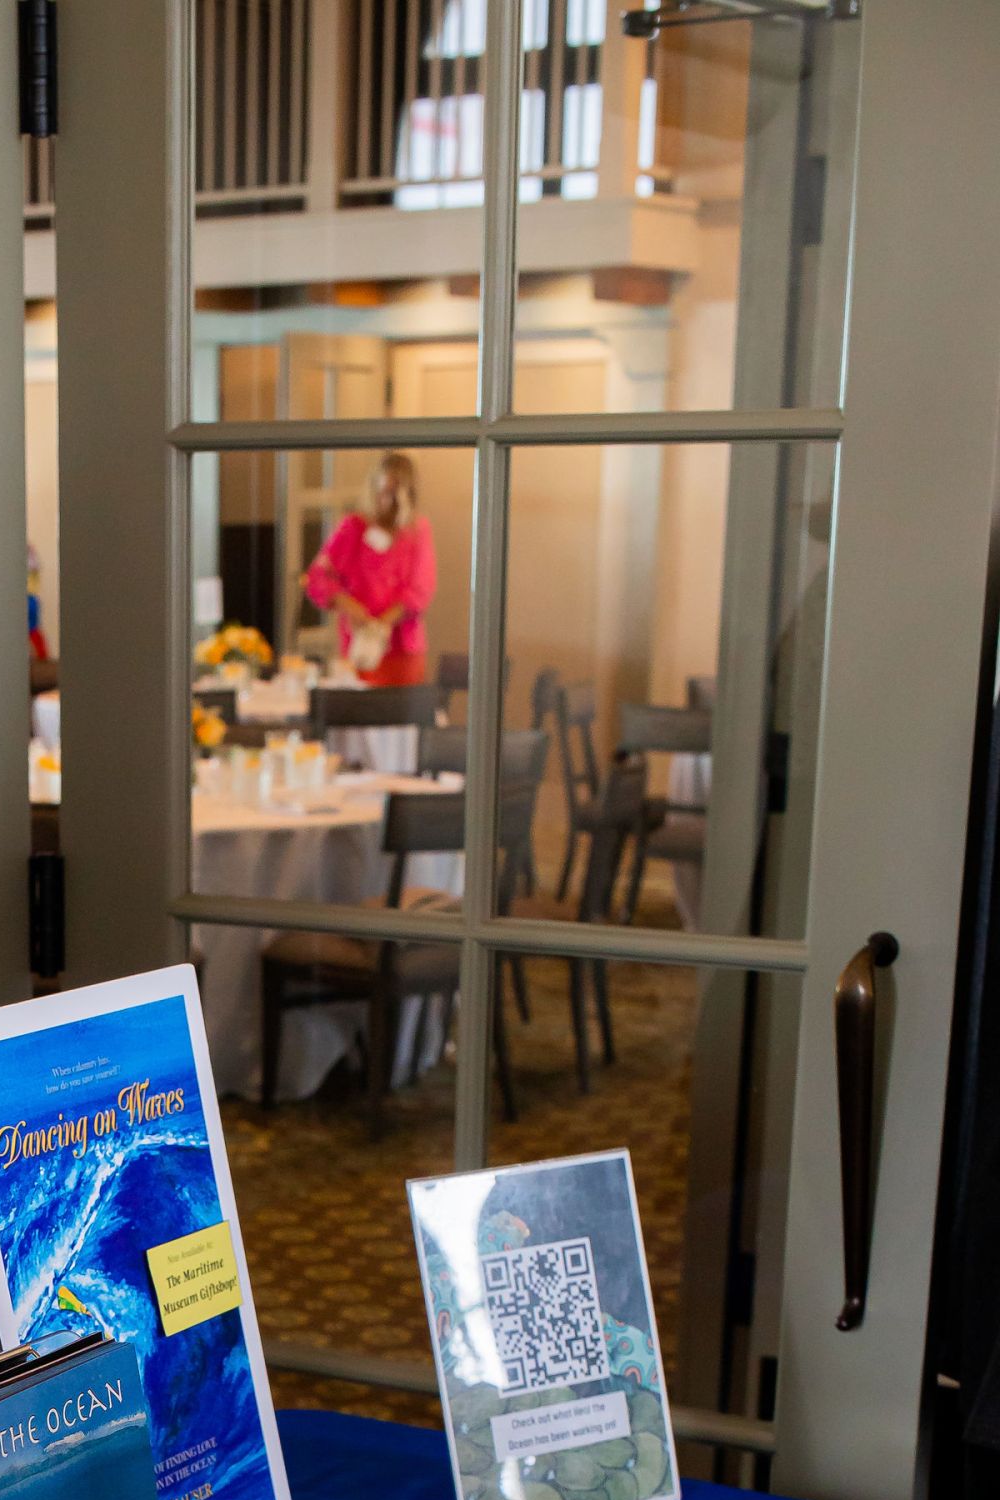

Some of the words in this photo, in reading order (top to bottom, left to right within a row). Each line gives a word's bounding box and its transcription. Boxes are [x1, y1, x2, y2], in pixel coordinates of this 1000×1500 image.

[94, 1107, 119, 1137] on
[117, 1078, 186, 1126] Waves
[165, 1275, 182, 1290] The
[183, 1258, 224, 1283] Maritime
[162, 1292, 199, 1317] Museum
[199, 1276, 238, 1302] Giftshop!
[46, 1380, 124, 1434] OCEAN
[511, 1415, 535, 1429] Check
[164, 1446, 197, 1469] FINDING
[196, 1436, 218, 1454] LOVE
[172, 1465, 191, 1482] THE
[189, 1453, 218, 1474] OCEAN
